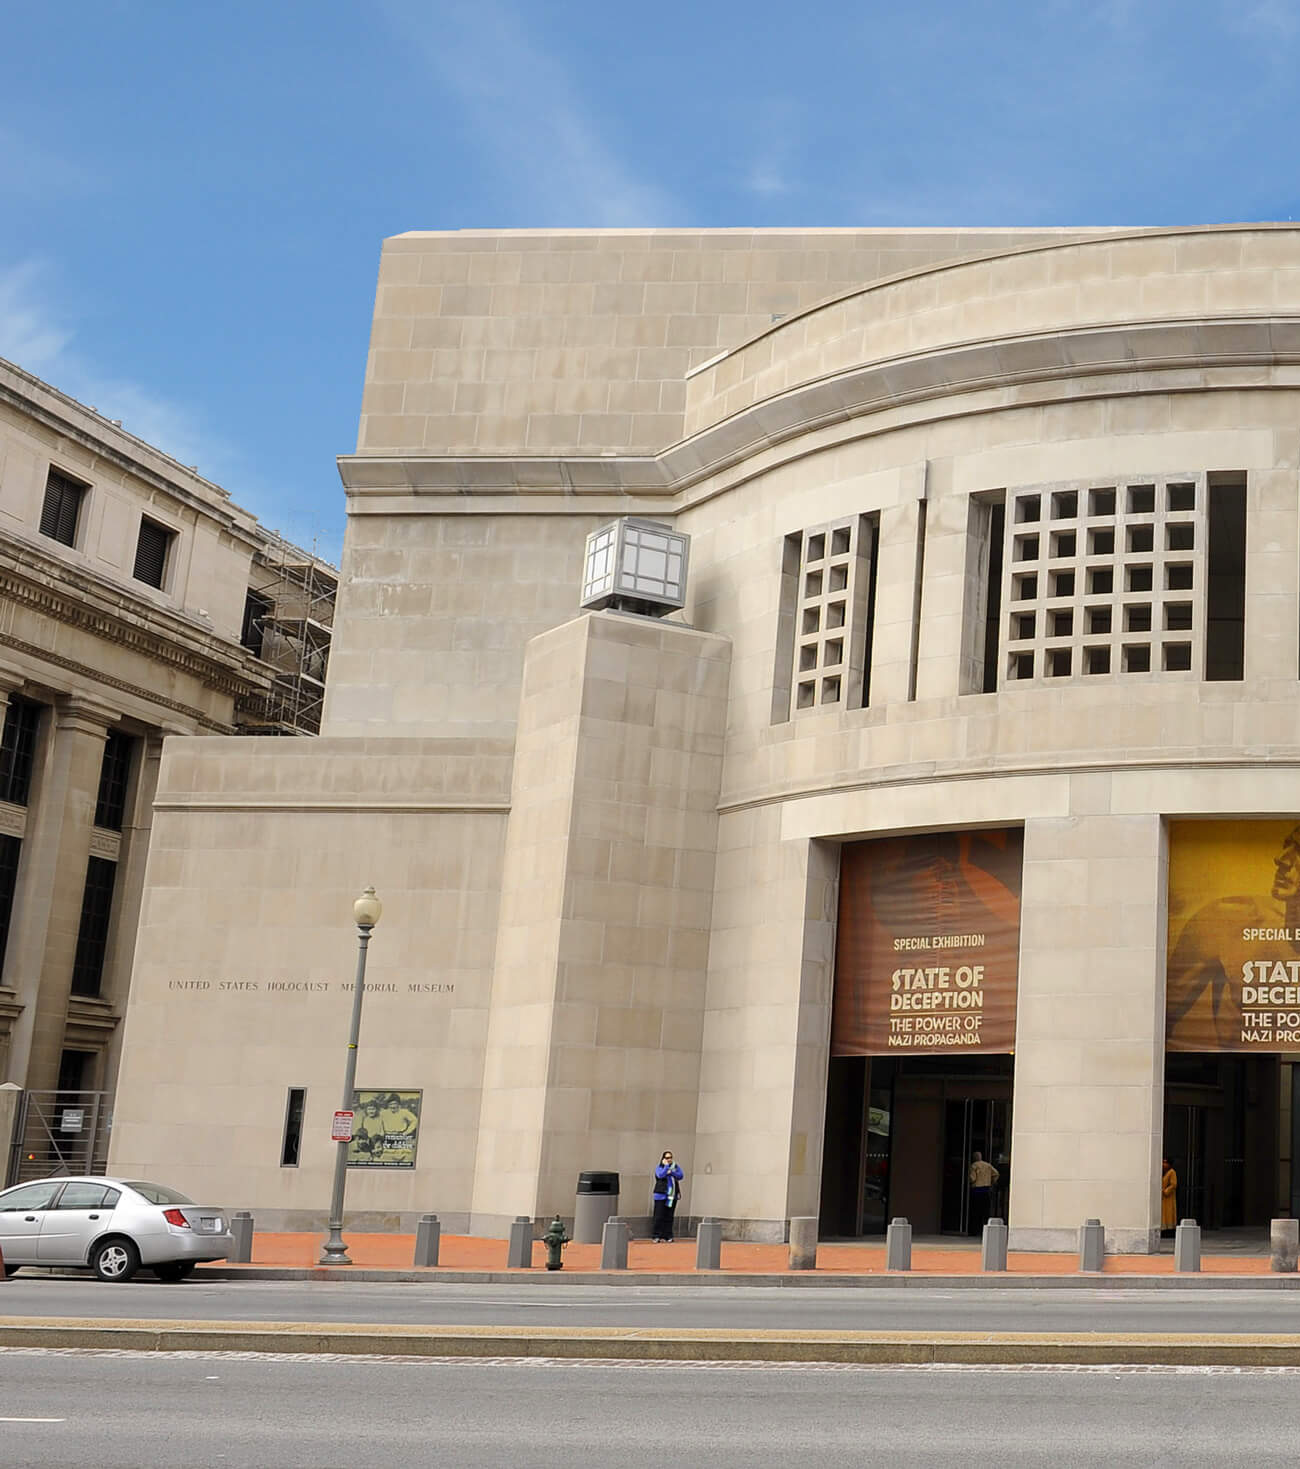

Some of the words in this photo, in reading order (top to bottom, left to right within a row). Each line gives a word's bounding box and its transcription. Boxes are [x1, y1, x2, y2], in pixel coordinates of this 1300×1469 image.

[1243, 928, 1292, 941] SPECIAL
[893, 937, 931, 950] SPECIAL
[933, 934, 985, 949] EXHIBITION
[892, 967, 950, 991] STATE
[955, 966, 985, 988] OF
[168, 981, 210, 990] UNITED
[219, 981, 258, 991] STATES
[267, 982, 329, 992] HOLOCAUST
[408, 984, 455, 993] MUSEUM
[890, 991, 984, 1010] DECEPTION
[890, 1018, 913, 1032] THE
[916, 1017, 960, 1031] POWER
[964, 1016, 982, 1030] OF
[1242, 1013, 1272, 1027] THE
[888, 1034, 911, 1046] NAZI
[913, 1032, 981, 1046] PROPAGANDA
[1241, 1030, 1272, 1042] NAZI
